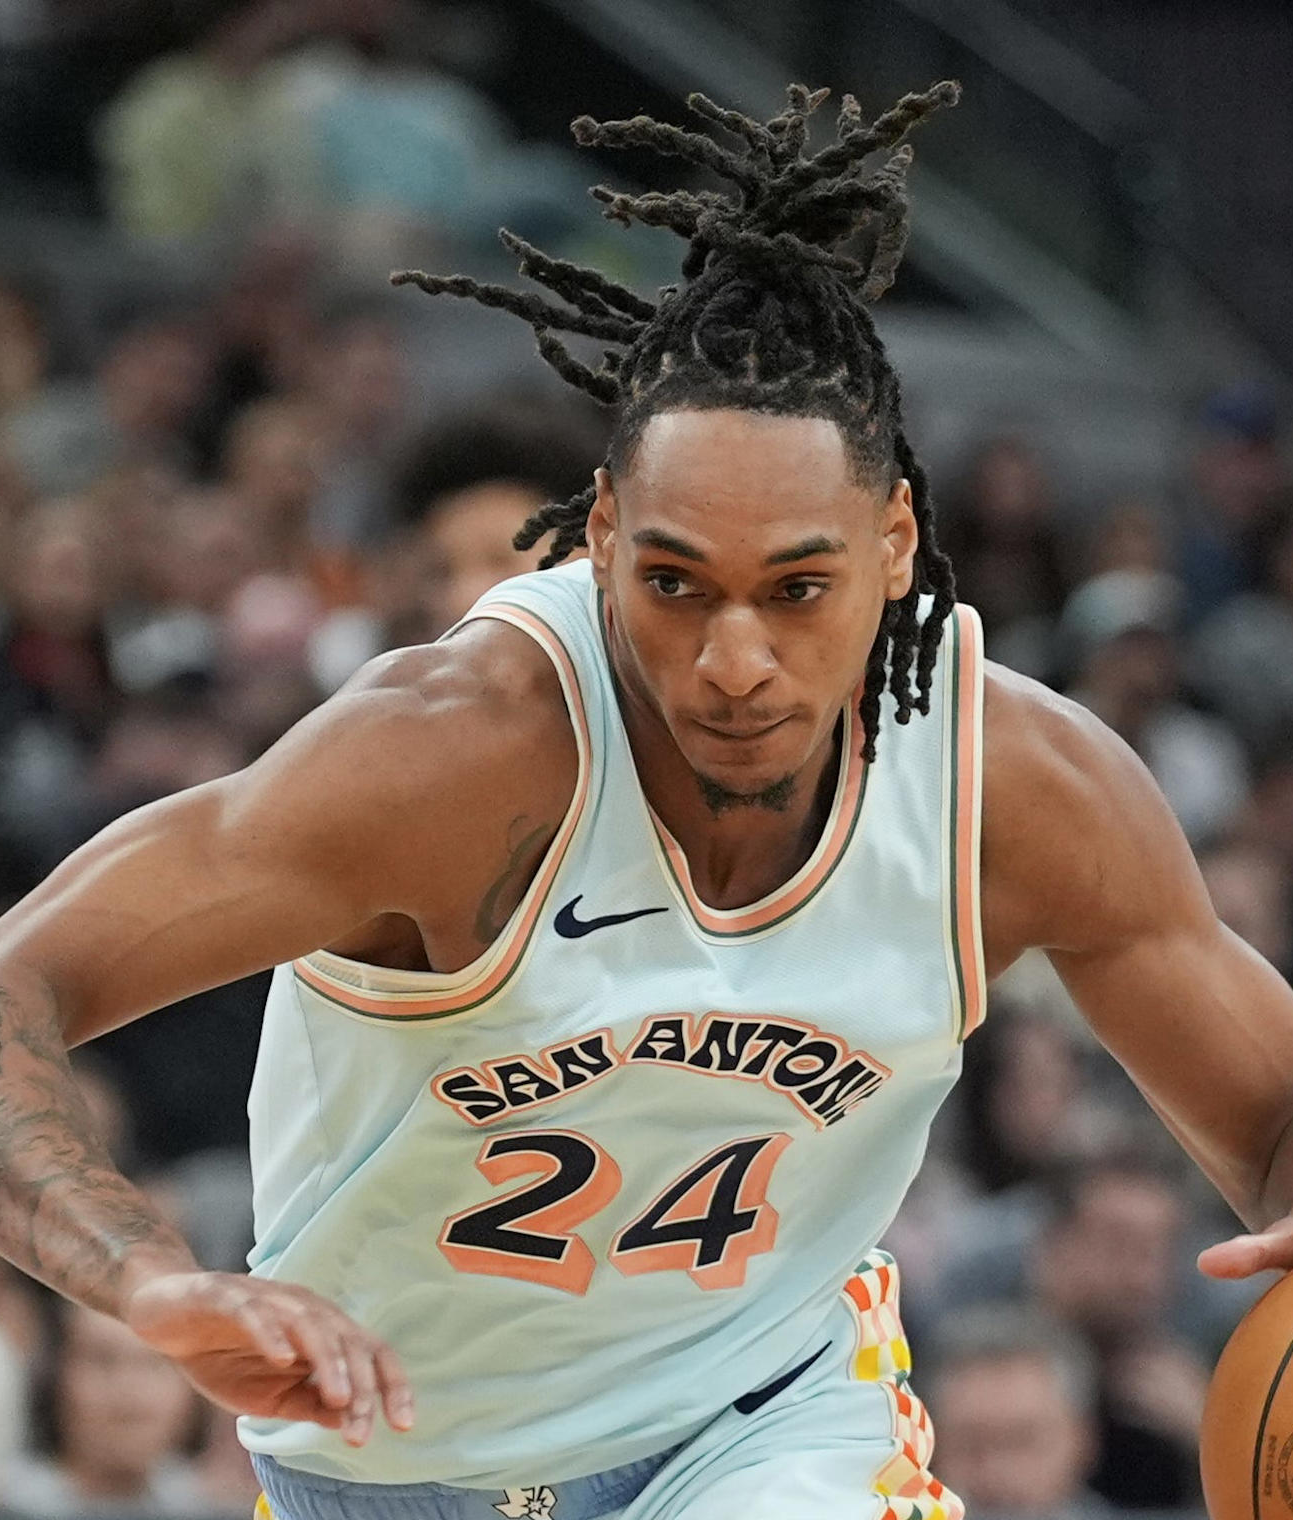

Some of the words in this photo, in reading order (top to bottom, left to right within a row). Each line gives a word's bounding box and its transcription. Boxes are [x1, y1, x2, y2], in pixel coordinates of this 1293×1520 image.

[433, 1028, 618, 1126] SAN
[625, 1011, 892, 1132] ANTON
[437, 1128, 793, 1296] 24
